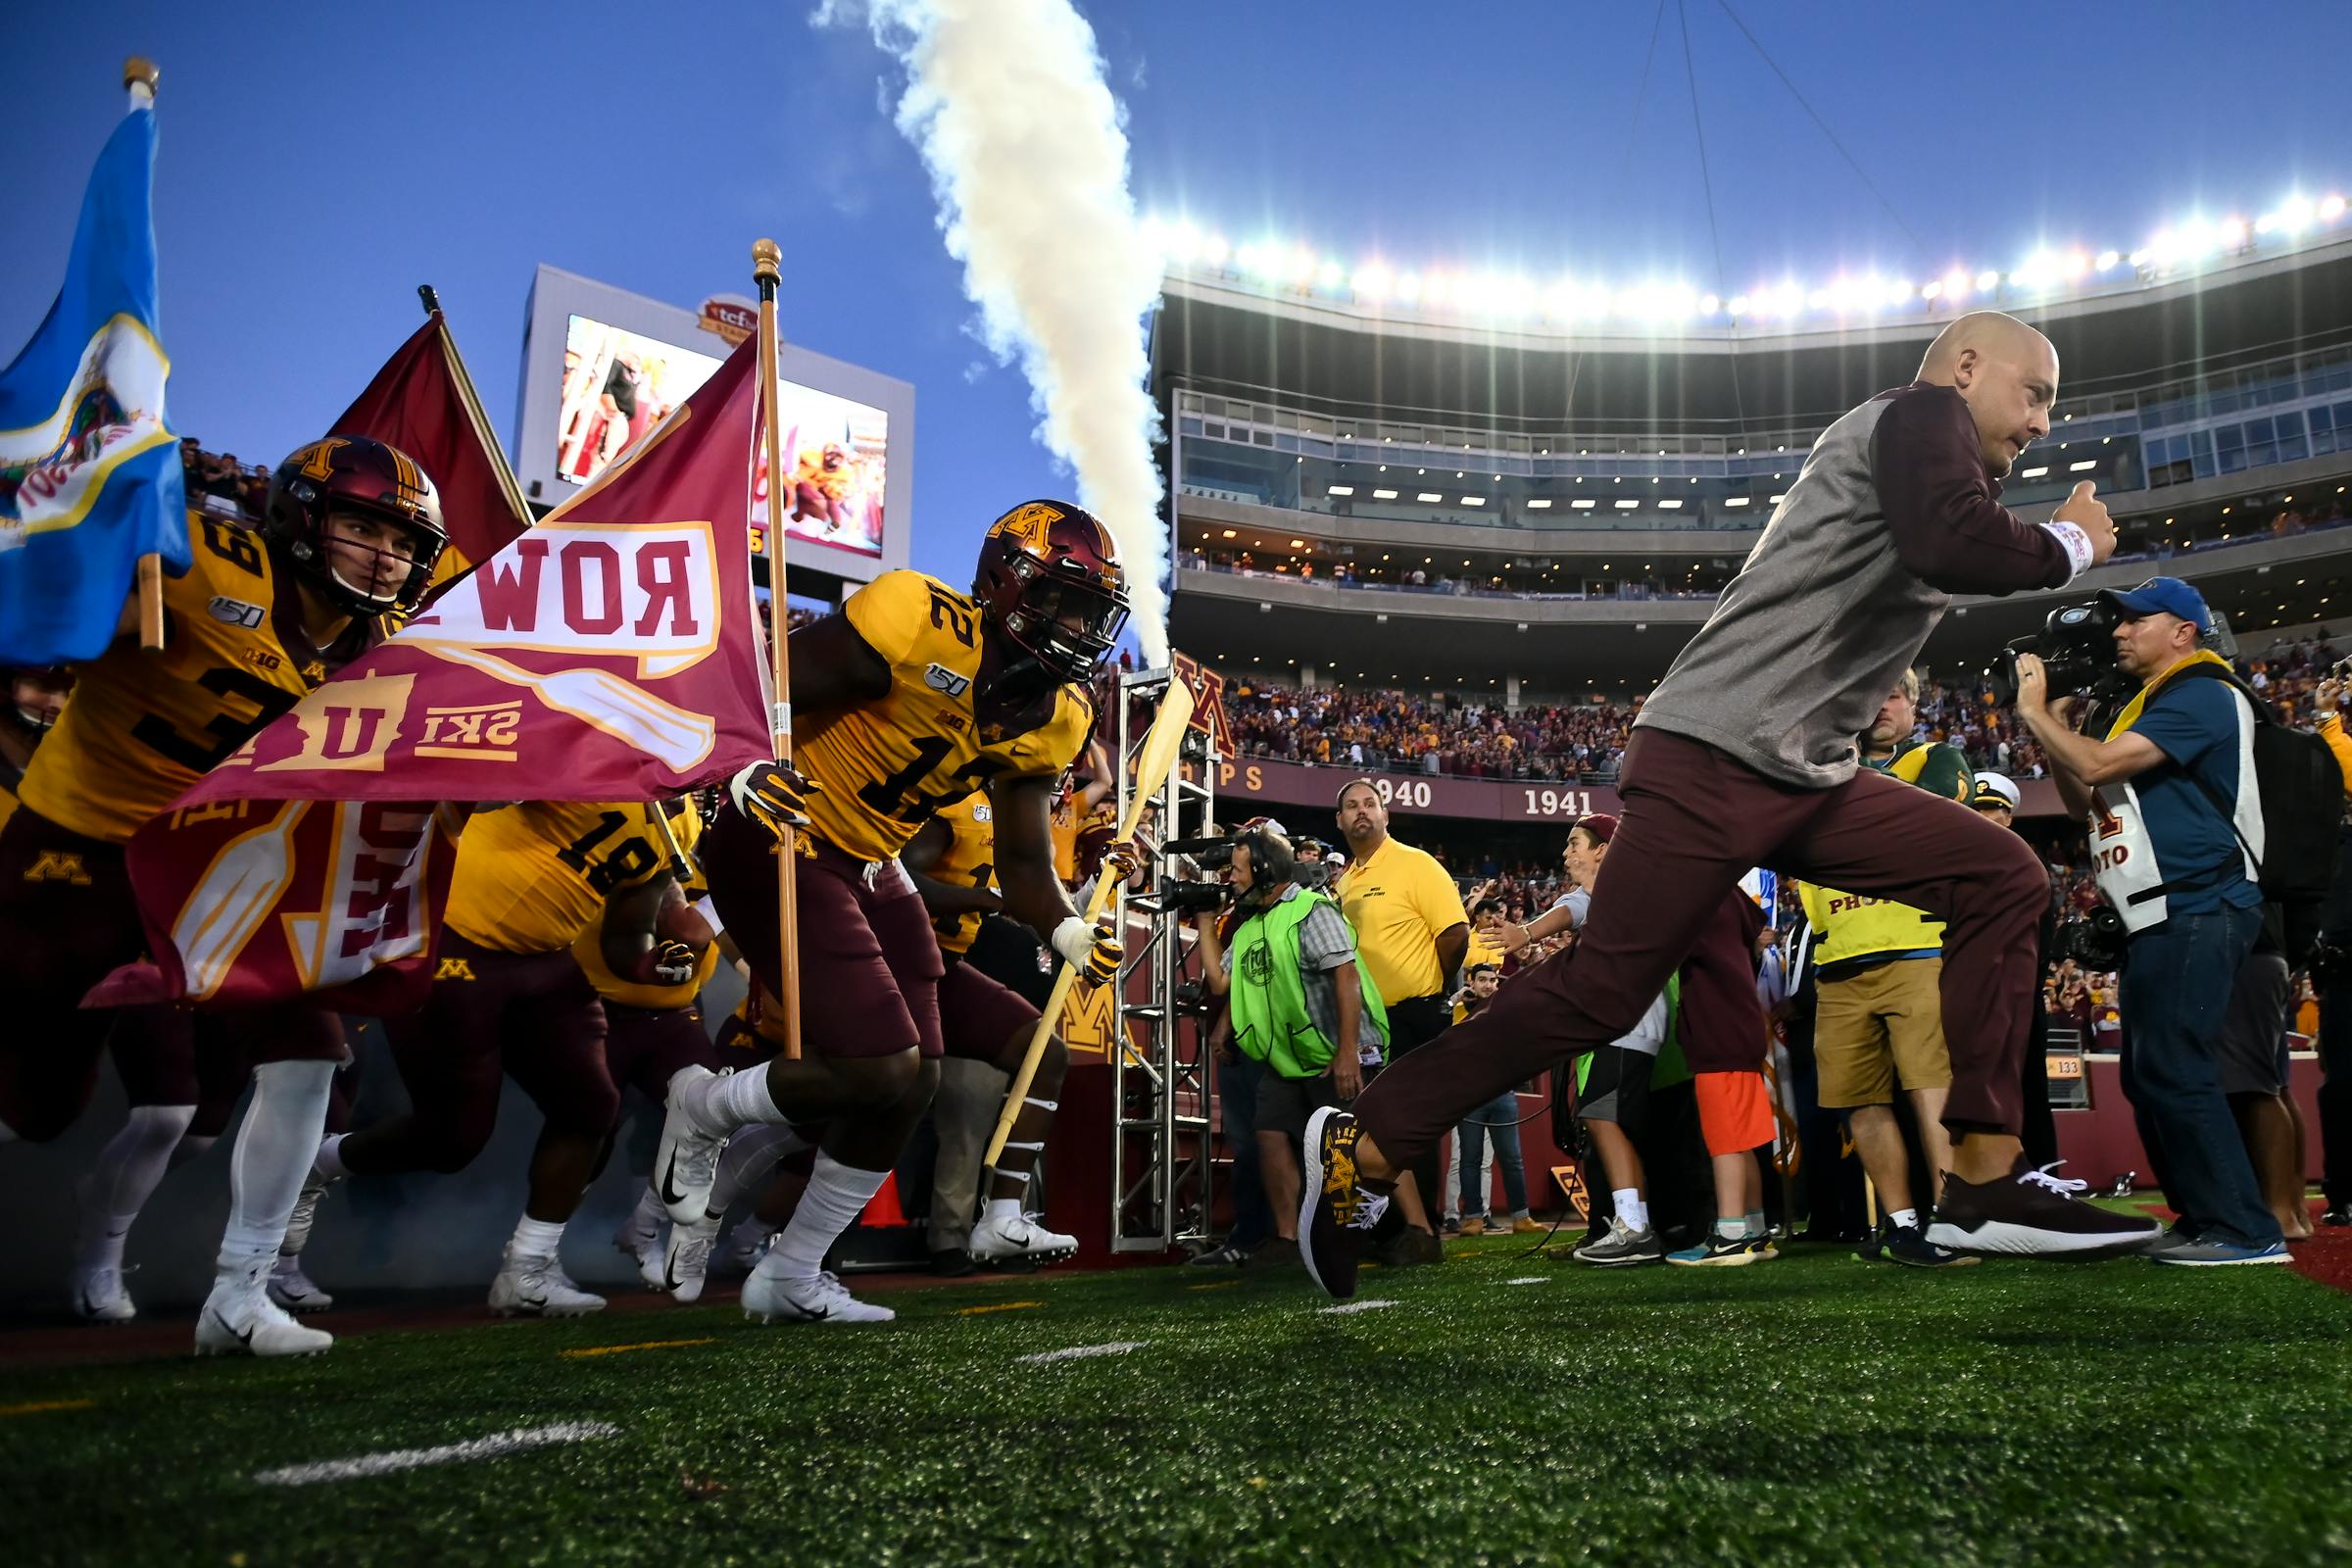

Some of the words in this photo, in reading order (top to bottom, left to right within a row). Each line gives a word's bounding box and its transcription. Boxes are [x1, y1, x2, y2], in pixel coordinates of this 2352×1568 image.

[986, 503, 1066, 561] M
[1360, 777, 1432, 808] 940
[1525, 789, 1593, 817] 1941
[434, 956, 477, 980] M
[2058, 1061, 2079, 1074] 133
